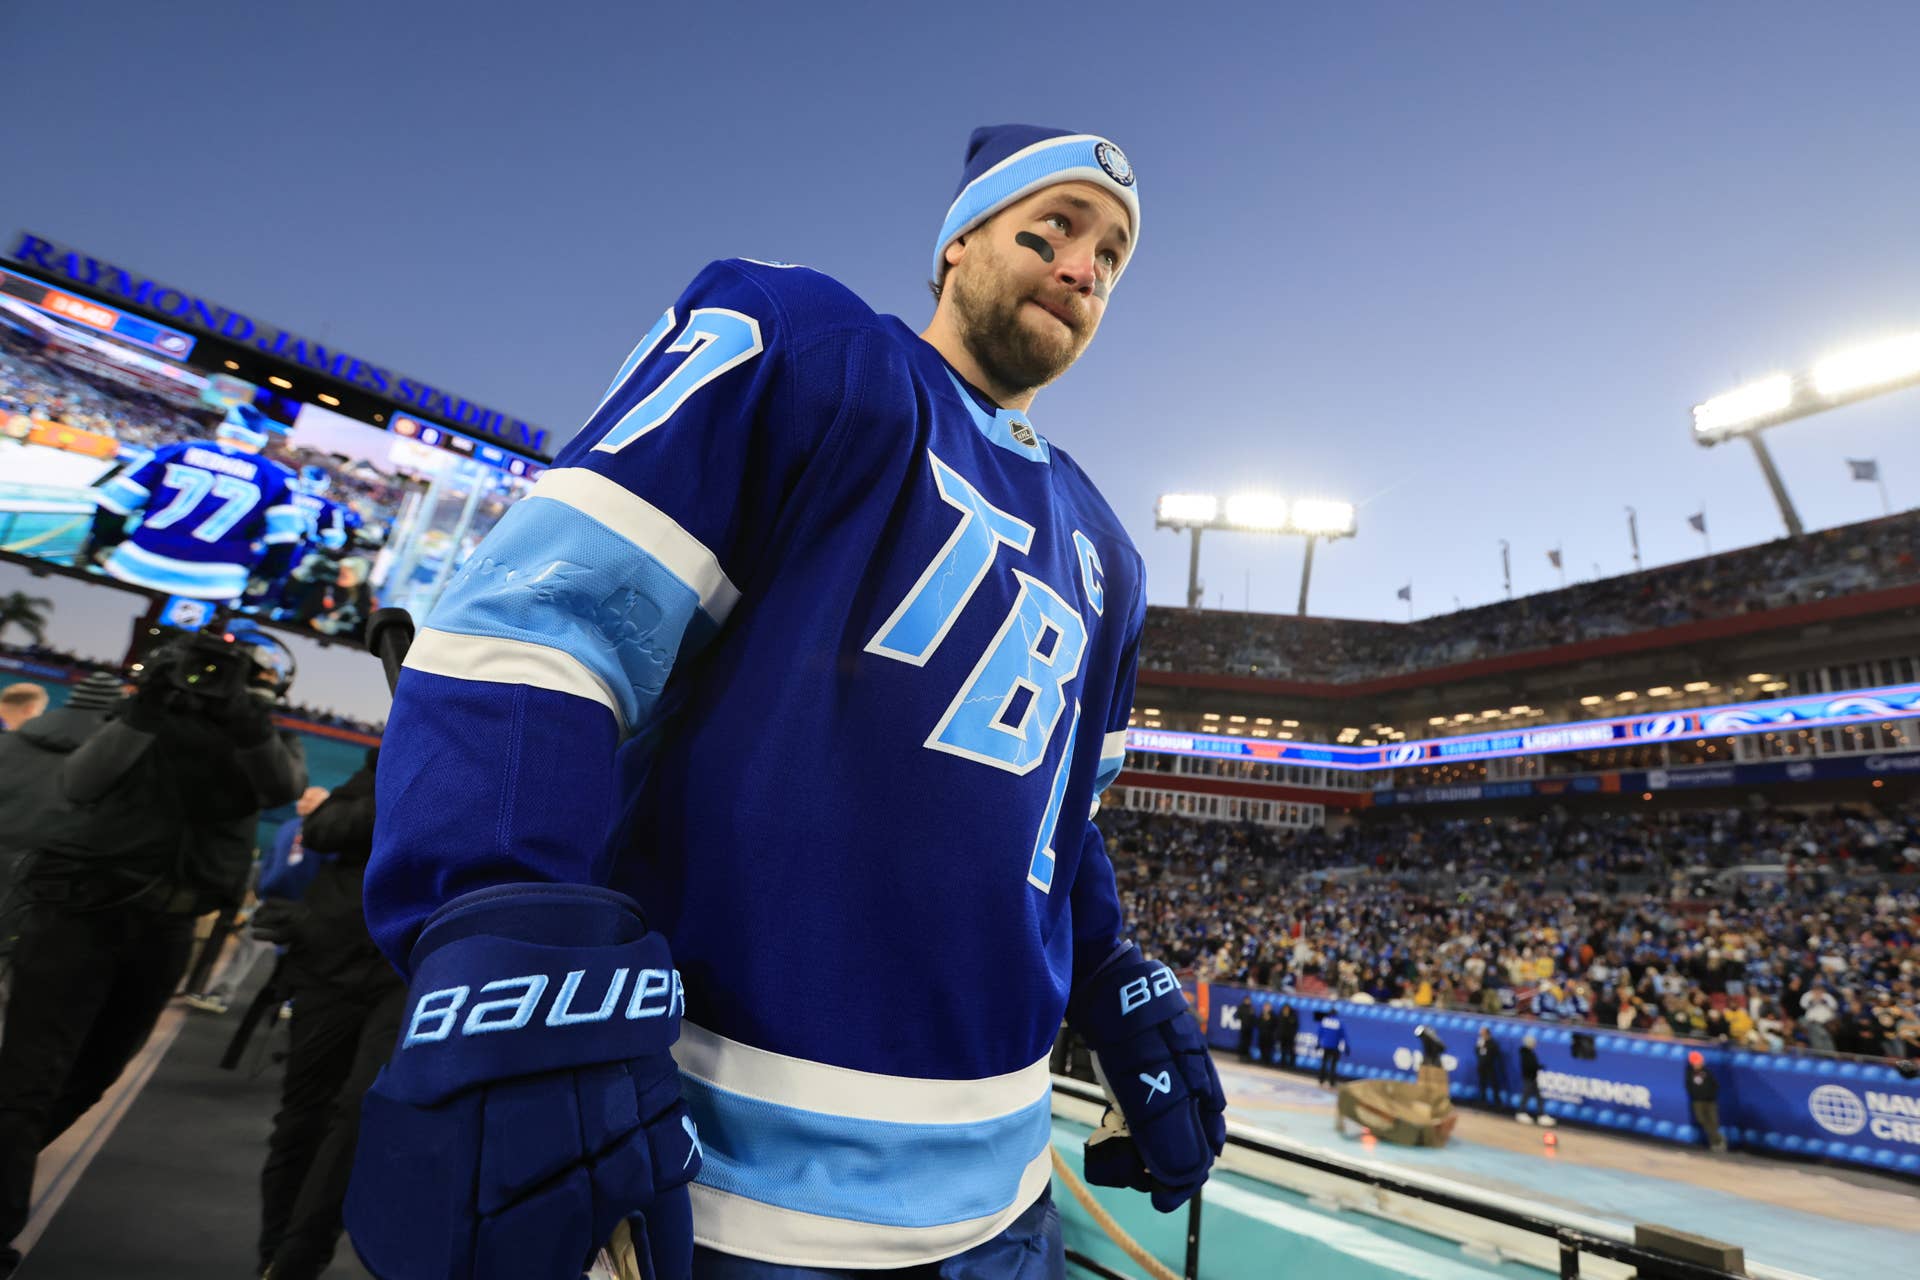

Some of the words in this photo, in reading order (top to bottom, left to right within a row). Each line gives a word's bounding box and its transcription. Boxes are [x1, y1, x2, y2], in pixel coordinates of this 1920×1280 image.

[15, 233, 256, 342] RAYMOND
[256, 330, 391, 392] JAMES
[393, 376, 547, 451] STADIUM
[144, 462, 261, 543] 77
[1072, 529, 1104, 617] C
[1133, 733, 1193, 751] STADIUM
[1522, 725, 1614, 748] LIGHTNING
